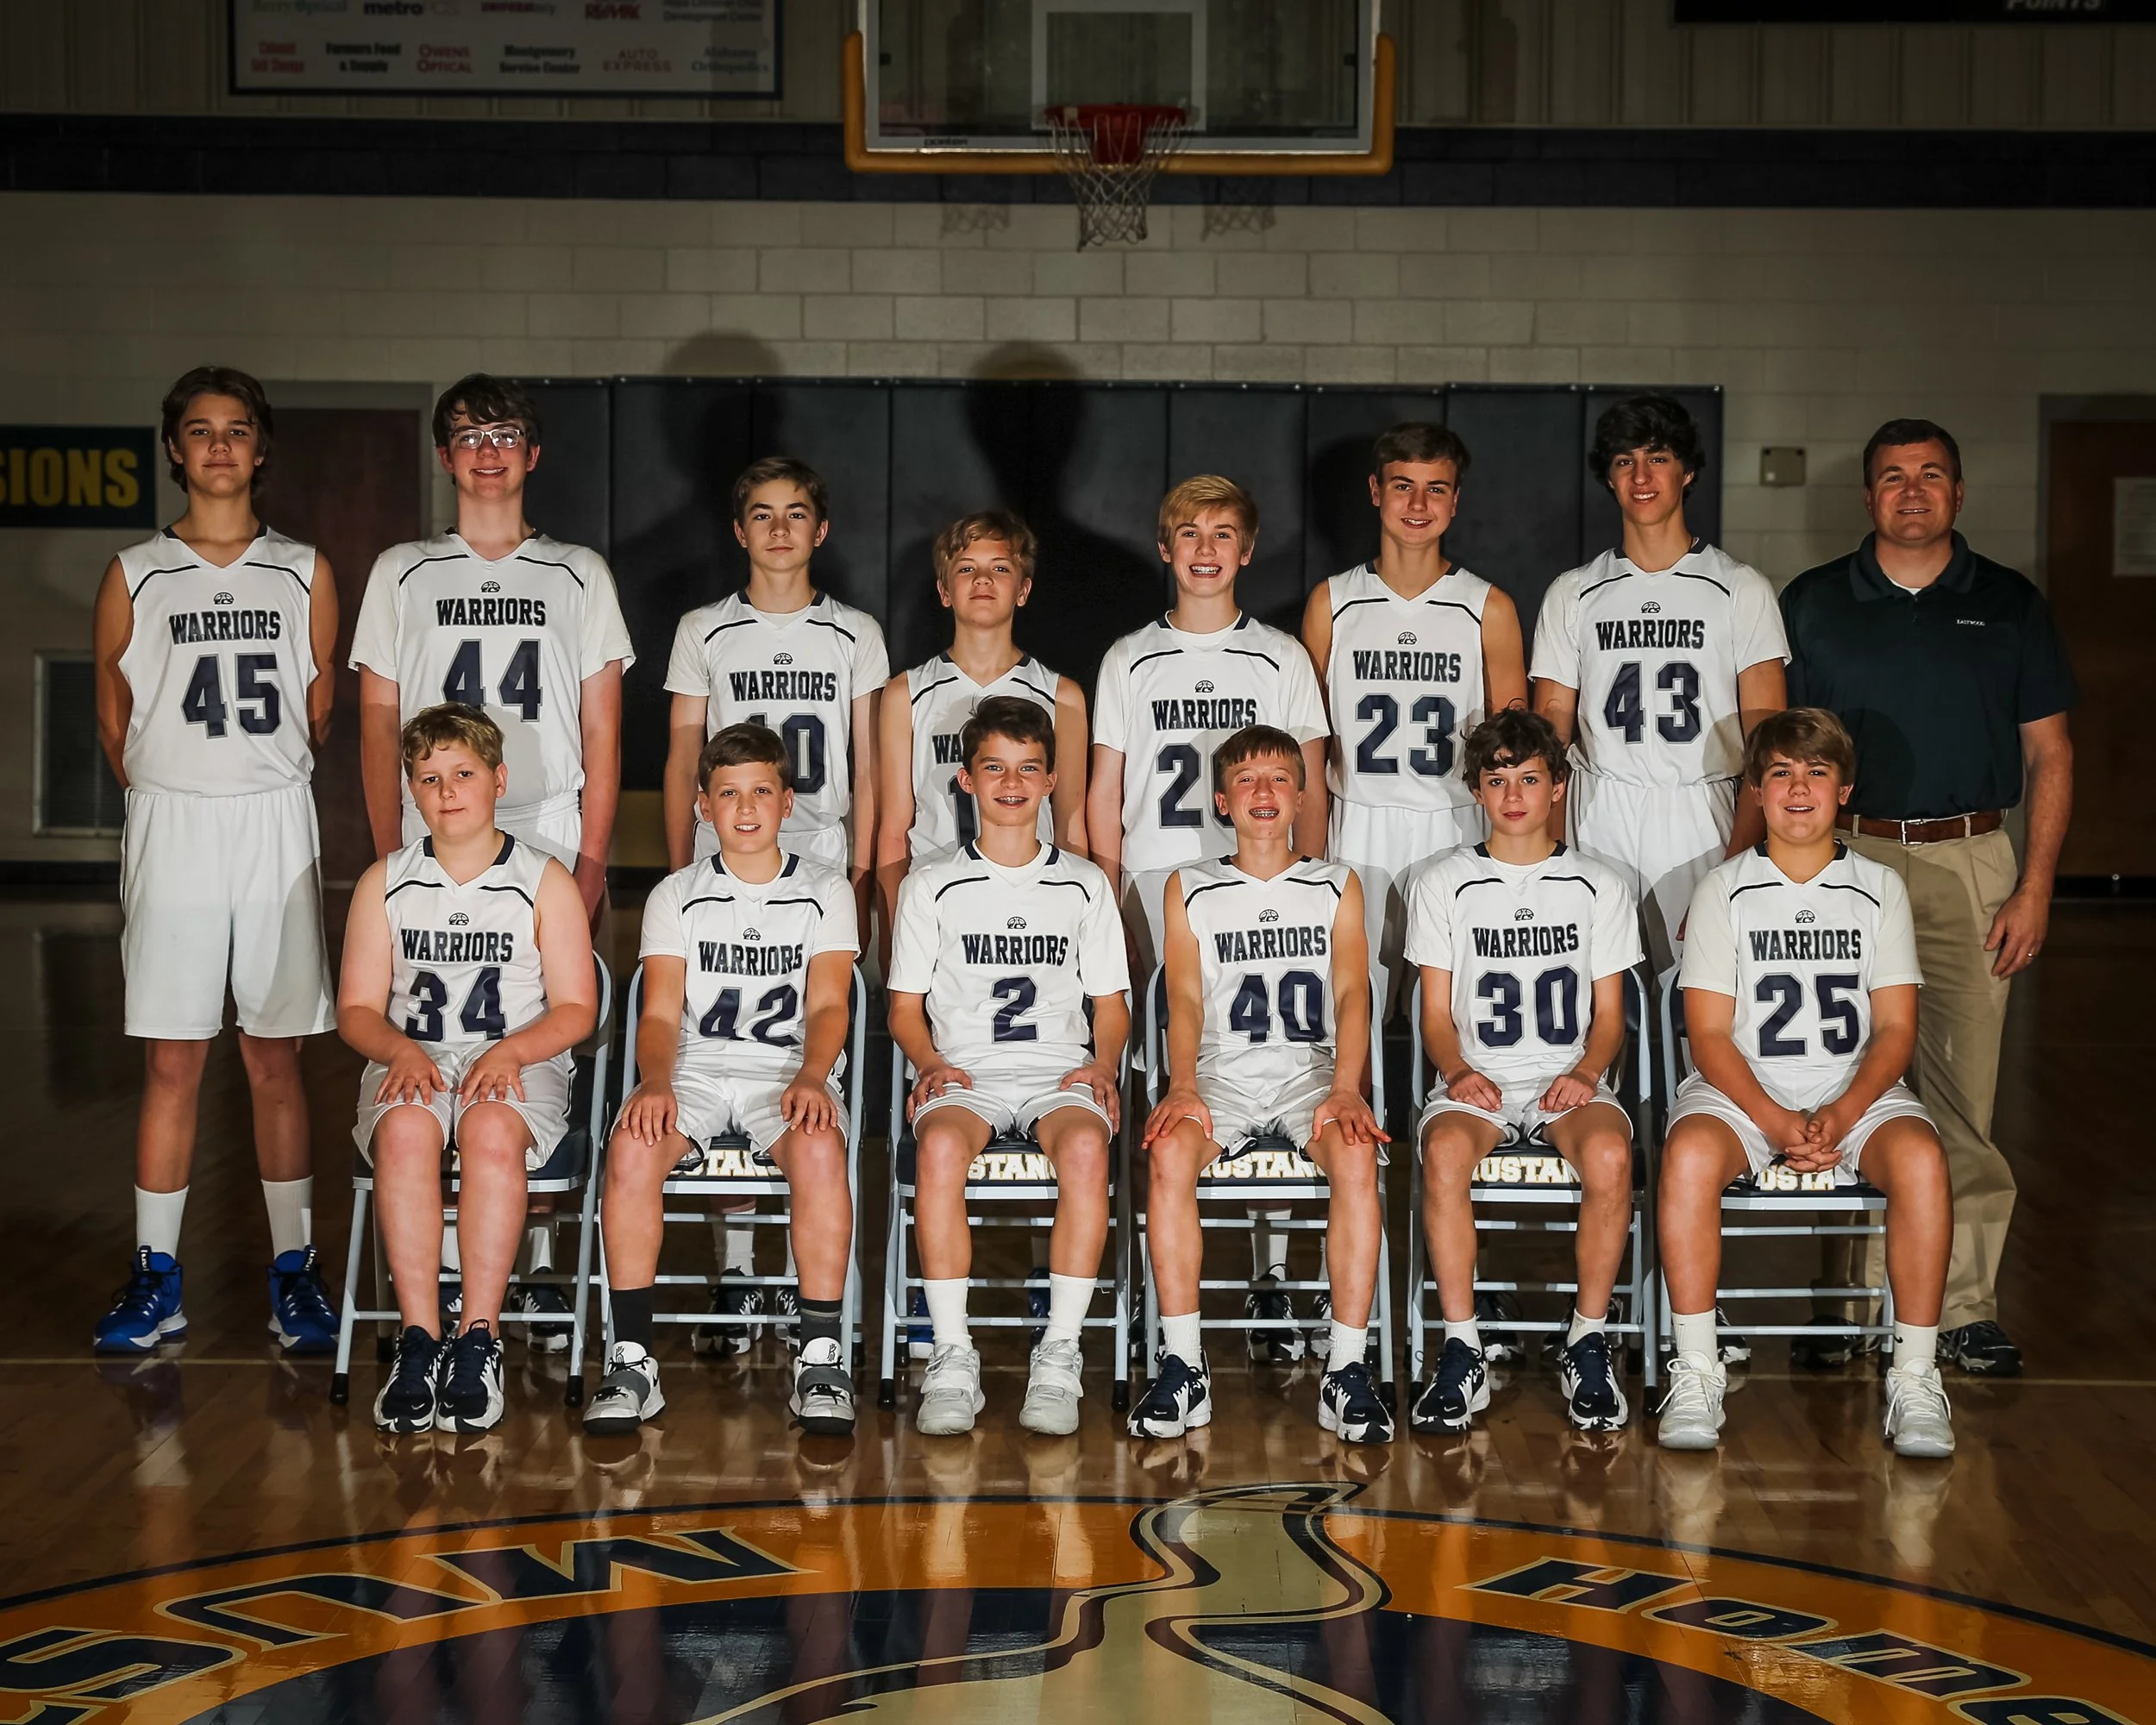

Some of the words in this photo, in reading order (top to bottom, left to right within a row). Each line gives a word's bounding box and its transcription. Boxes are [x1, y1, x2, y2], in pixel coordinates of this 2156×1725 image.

[363, 0, 423, 16] metro
[417, 59, 473, 74] OPTICAL
[603, 60, 673, 72] EXPRESS
[618, 49, 658, 60] AUTO
[0, 447, 140, 508] IONS
[169, 609, 281, 645] WARRIORS
[436, 598, 546, 627] WARRIORS
[1595, 618, 1706, 651] WARRIORS
[440, 638, 543, 723] 44
[1352, 650, 1461, 683] WARRIORS
[180, 652, 282, 739] 45
[729, 670, 837, 702] WARRIORS
[1604, 660, 1703, 744] 43
[1150, 699, 1257, 731] WARRIORS
[744, 712, 827, 795] 0
[1354, 693, 1457, 778] 23
[400, 928, 514, 963] WARRIORS
[699, 940, 803, 976] WARRIORS
[961, 934, 1069, 967] WARRIORS
[1214, 925, 1326, 964] WARRIORS
[1471, 923, 1580, 958] WARRIORS
[1749, 929, 1862, 963] WARRIORS
[404, 965, 506, 1043] 34
[699, 983, 804, 1047] 42
[990, 975, 1040, 1044] 2
[1227, 968, 1327, 1045] 40
[1475, 964, 1580, 1050] 30
[1754, 971, 1861, 1059] 25
